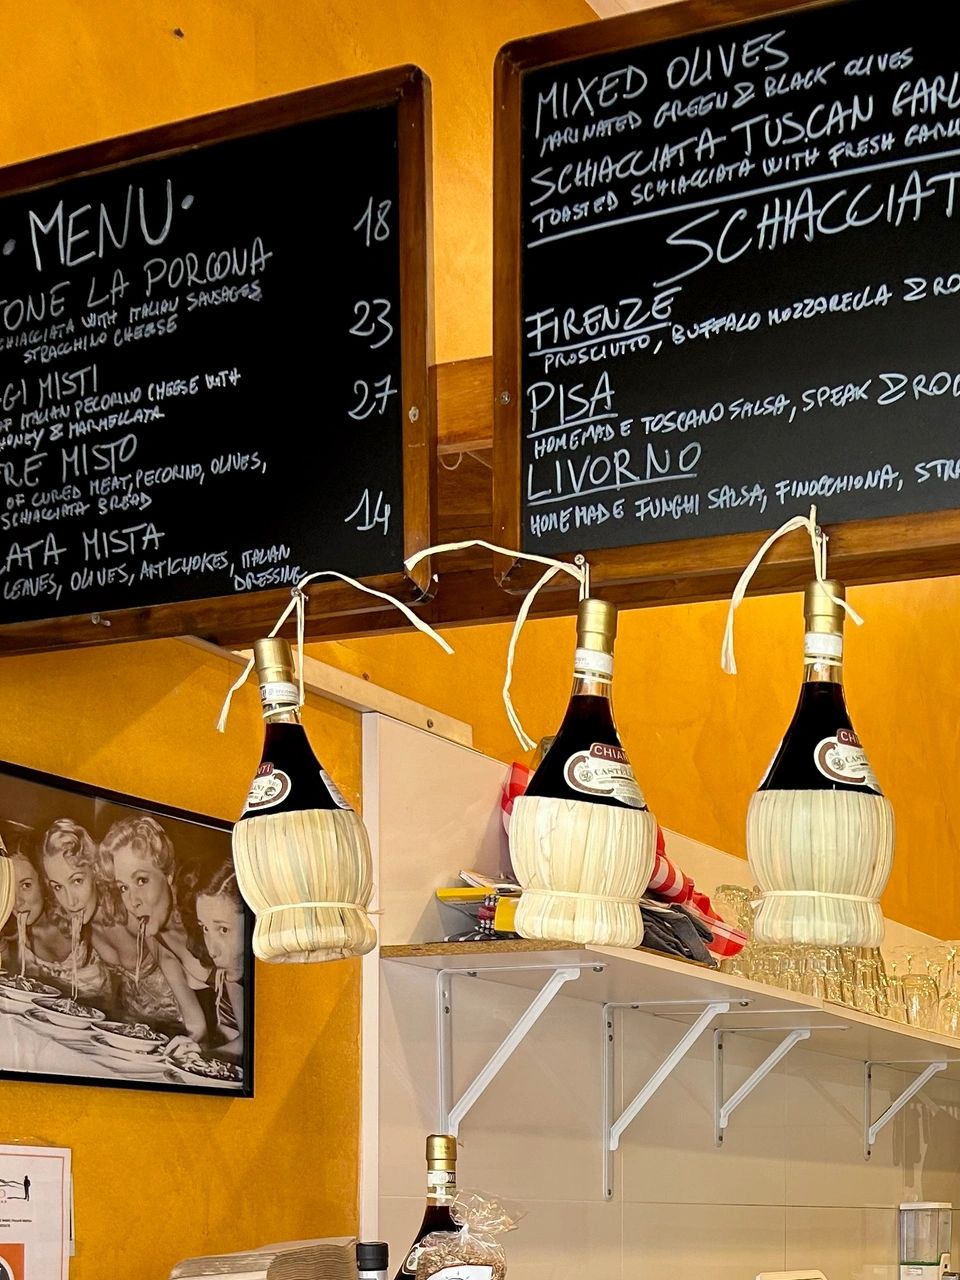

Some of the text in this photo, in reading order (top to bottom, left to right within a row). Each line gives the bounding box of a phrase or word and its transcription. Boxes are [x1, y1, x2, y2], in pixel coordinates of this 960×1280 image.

[536, 65, 648, 138] MIXED
[667, 30, 789, 89] OLIVES
[540, 110, 643, 158] MARINATED
[654, 89, 728, 129] GREEN
[765, 61, 836, 98] BLACK
[844, 47, 914, 75] OLIVES
[529, 126, 727, 207] SCHIACCIATA
[731, 94, 874, 156] TUSCAN
[531, 190, 619, 233] TOASTED
[630, 158, 756, 206] SCHIACCIATA
[763, 147, 820, 176] WITH
[828, 134, 895, 169] FRESH
[28, 179, 173, 271] MENU
[0, 196, 391, 331] ONE LA PORCONA 18
[81, 309, 118, 329] WITH
[129, 296, 179, 323] ITALIAN
[186, 279, 264, 311] SAUSAGES
[349, 298, 393, 348] 23
[525, 286, 683, 350] FIRENZE
[671, 311, 762, 345] BUFFALO
[767, 283, 892, 326] MOZZARELLA
[24, 313, 178, 364] STRACCHINO CHEESE
[0, 363, 97, 411] GI MISTI
[20, 404, 71, 431] ITALIAN
[75, 386, 142, 420] PECORINO
[147, 374, 199, 402] CHEESE
[205, 367, 241, 390] WITH
[348, 374, 397, 419] 27
[527, 371, 616, 431] PISA
[68, 404, 165, 440] MARMELLATA
[534, 418, 633, 460] HOMEMADE
[641, 403, 725, 434] TOSCANO
[802, 377, 873, 412] SPEAK
[0, 433, 138, 487] RE MISTO
[527, 441, 702, 500] LIVORNO
[0, 491, 153, 530] SCHIACCIATA BREAD
[6, 493, 26, 510] OF
[31, 485, 82, 507] CURED
[345, 488, 391, 535] 14
[529, 499, 625, 538] HOMEMADE
[635, 493, 700, 521] FUNGHI
[82, 523, 165, 562] MISTA
[241, 543, 291, 569] ITALIAN
[234, 565, 308, 591] DRESSING
